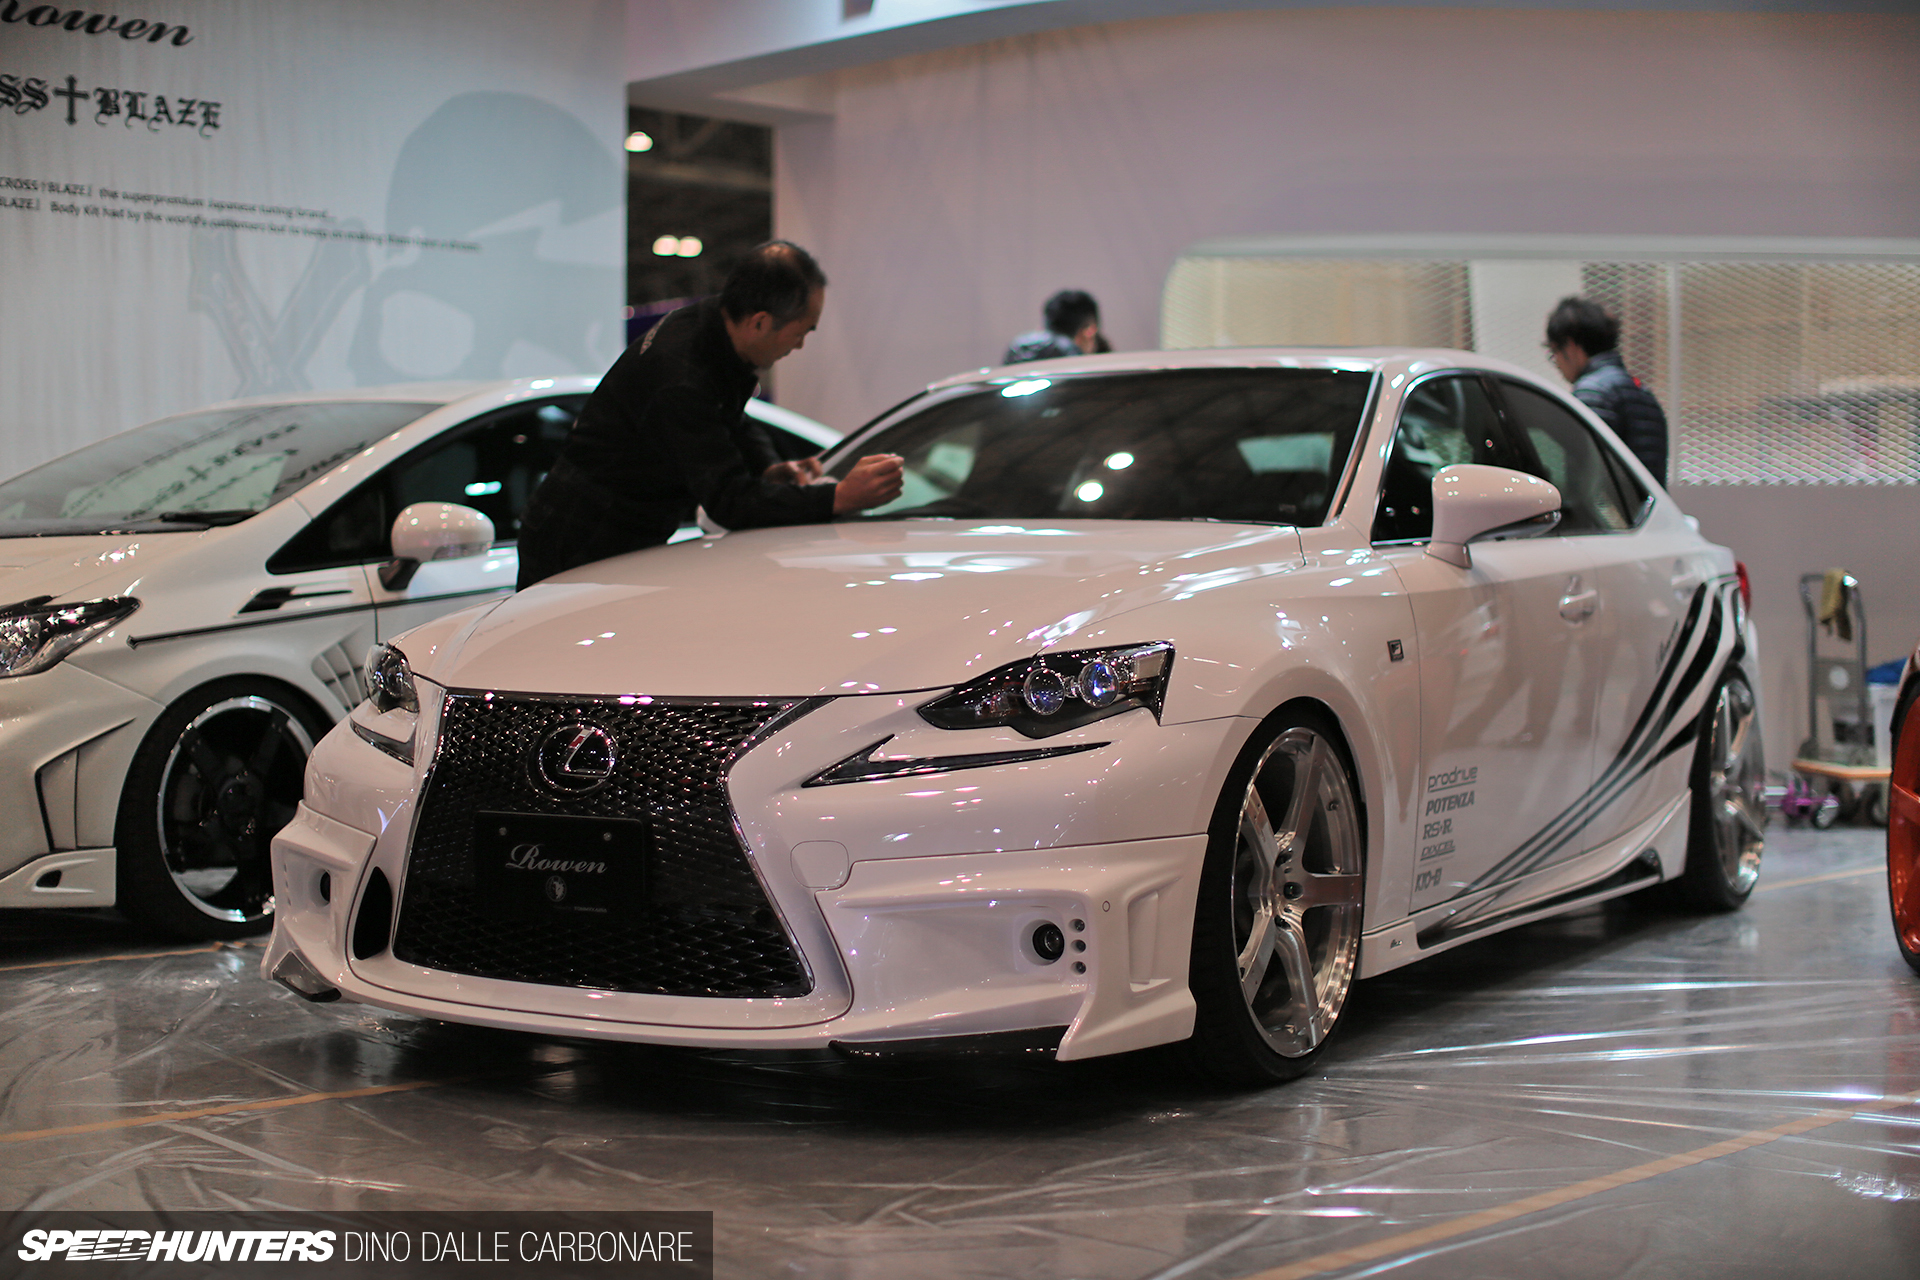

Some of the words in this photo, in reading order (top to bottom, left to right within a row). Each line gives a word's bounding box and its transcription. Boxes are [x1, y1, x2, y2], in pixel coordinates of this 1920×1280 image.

[0, 0, 194, 46] owen
[1425, 790, 1475, 817] POTENZA
[505, 843, 608, 874] Rowen
